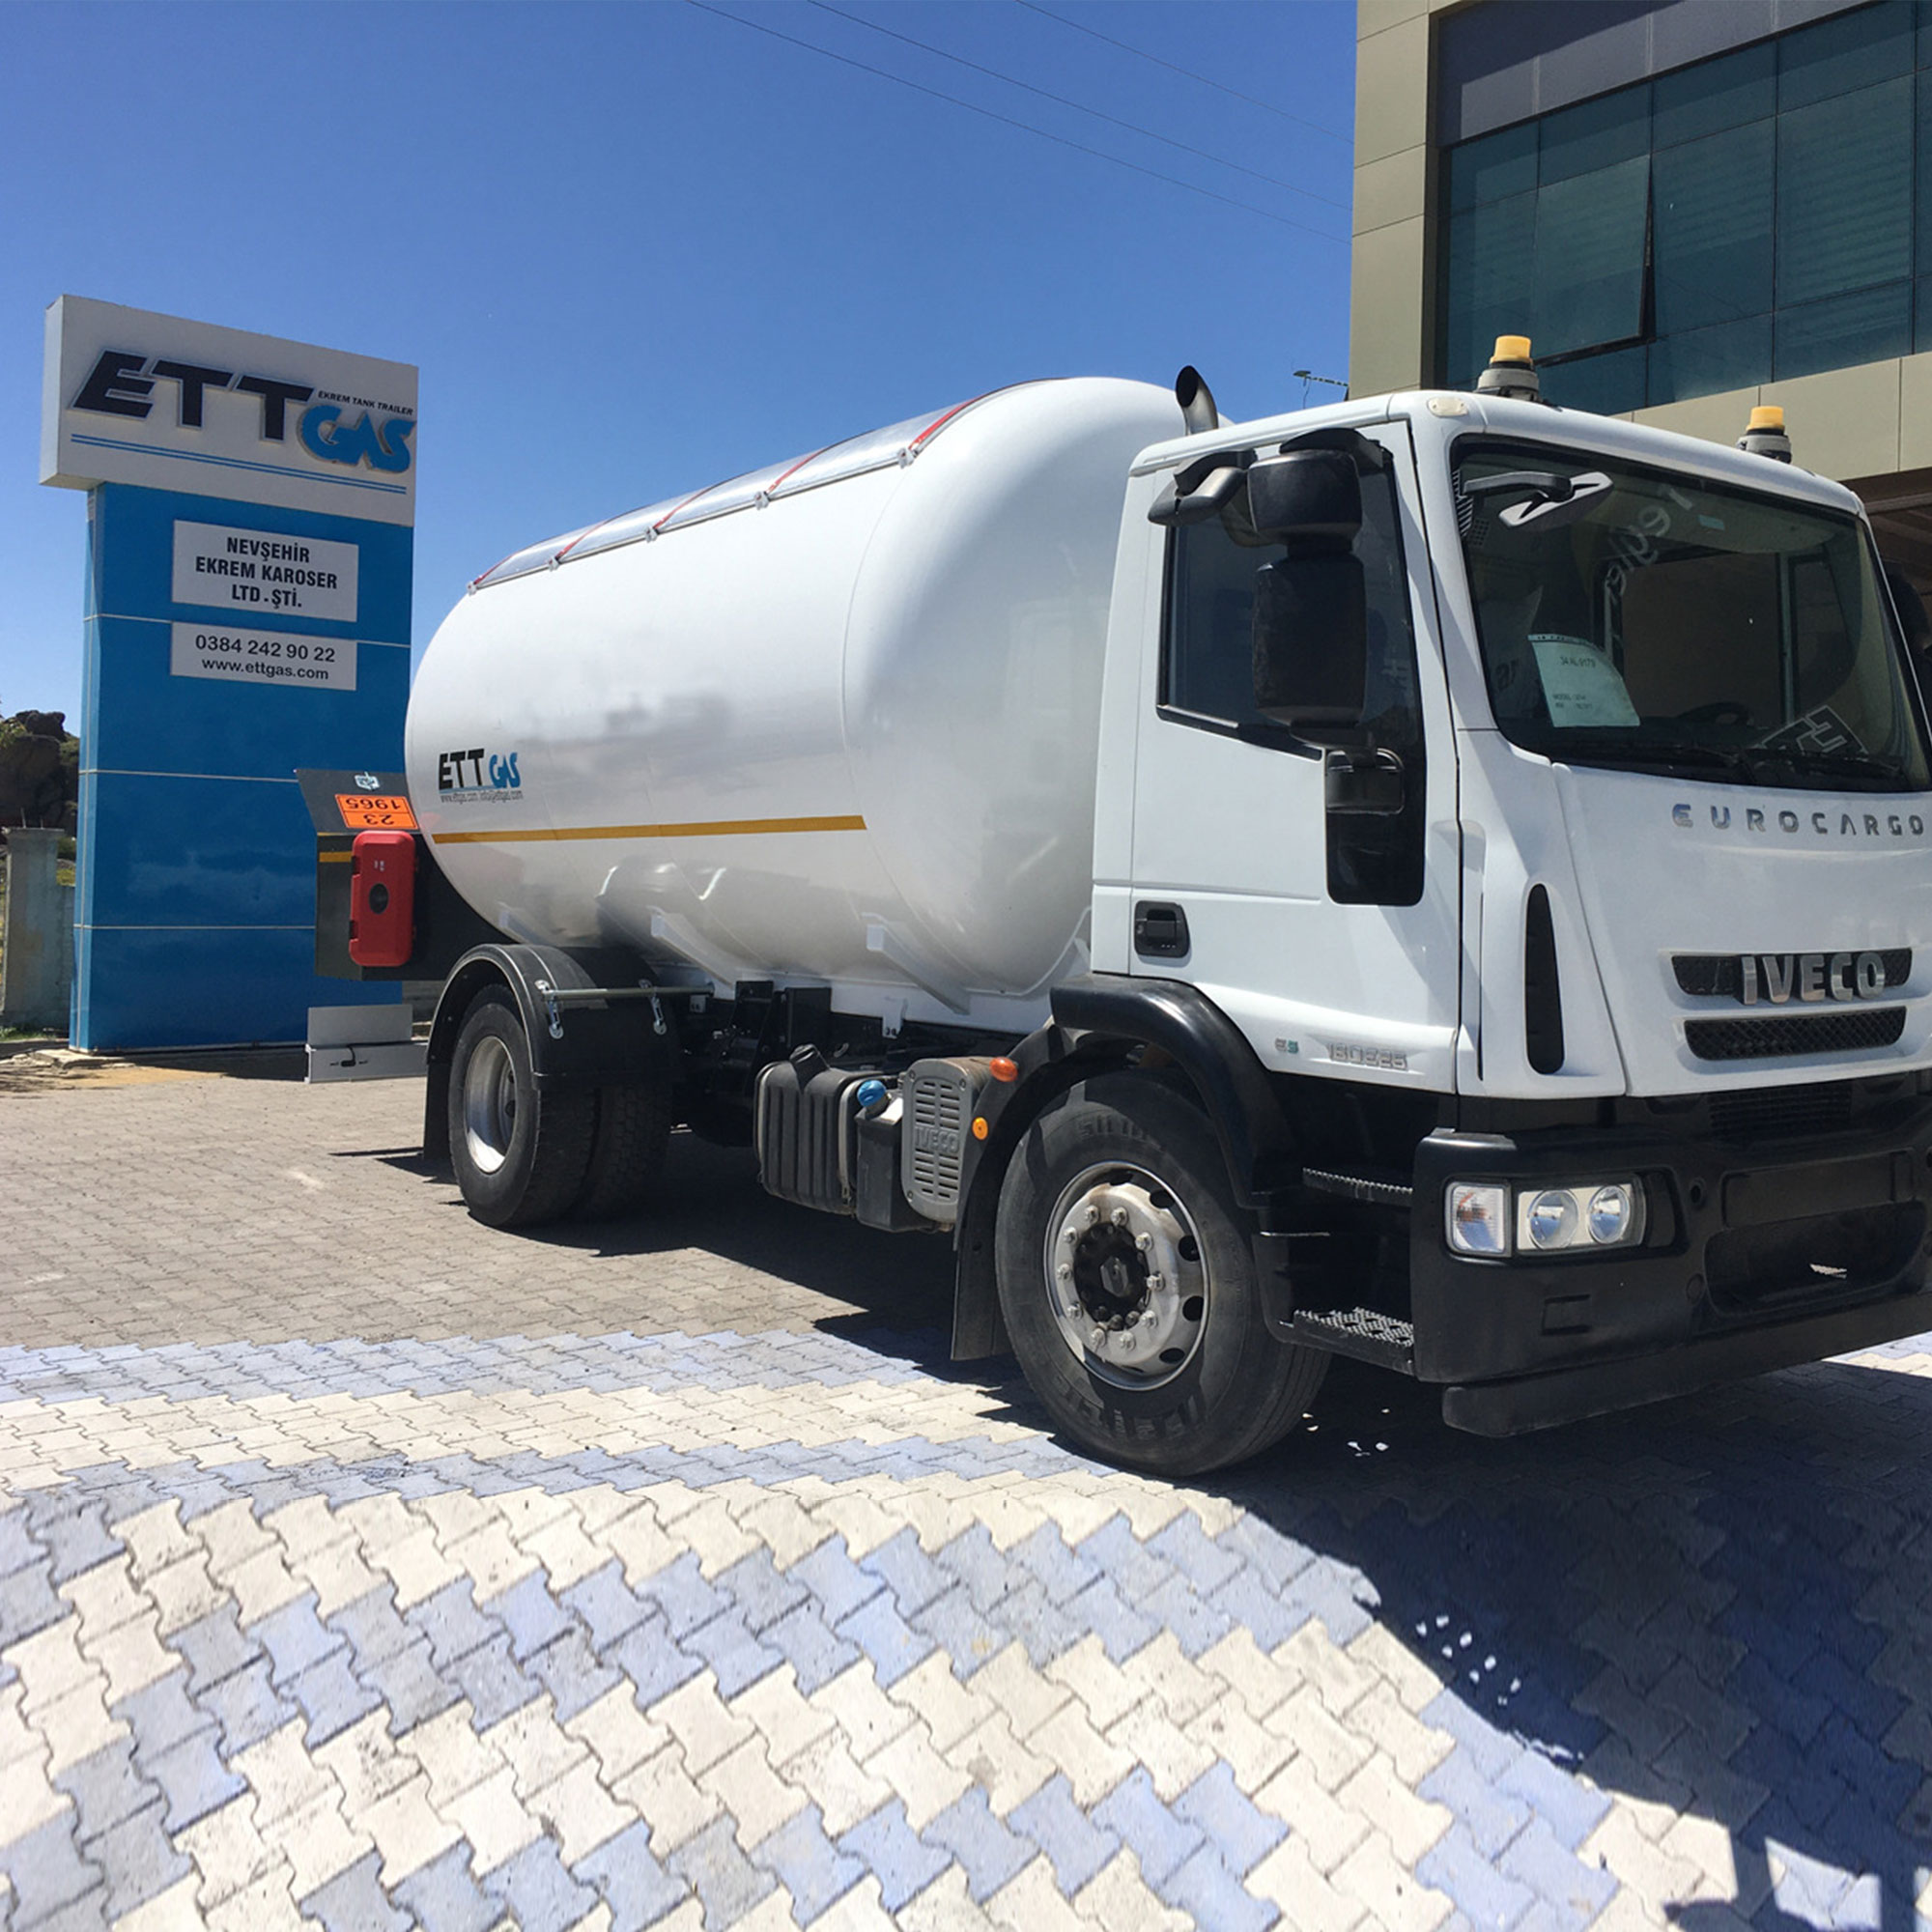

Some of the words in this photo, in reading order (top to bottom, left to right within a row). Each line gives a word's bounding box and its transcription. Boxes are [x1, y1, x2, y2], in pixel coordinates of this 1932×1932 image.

[318, 390, 350, 403] EKREM
[353, 397, 375, 409] TANK
[378, 402, 413, 415] TRAILER
[227, 536, 309, 563] NEVŞEHİR
[196, 556, 255, 580] EKREM
[262, 563, 337, 588] KAROSER
[196, 634, 242, 654] 0384
[248, 639, 281, 658] 242
[286, 643, 308, 661] 90
[314, 646, 335, 663] 22
[202, 658, 328, 680] www.ettgas.com
[439, 749, 484, 790] ETT
[489, 753, 521, 788] GAS
[346, 797, 401, 810] 1965
[363, 813, 394, 825] 23
[1672, 804, 1924, 837] EUROCARGO
[1741, 952, 1886, 1005] IVECO
[914, 1125, 959, 1152] IVECO
